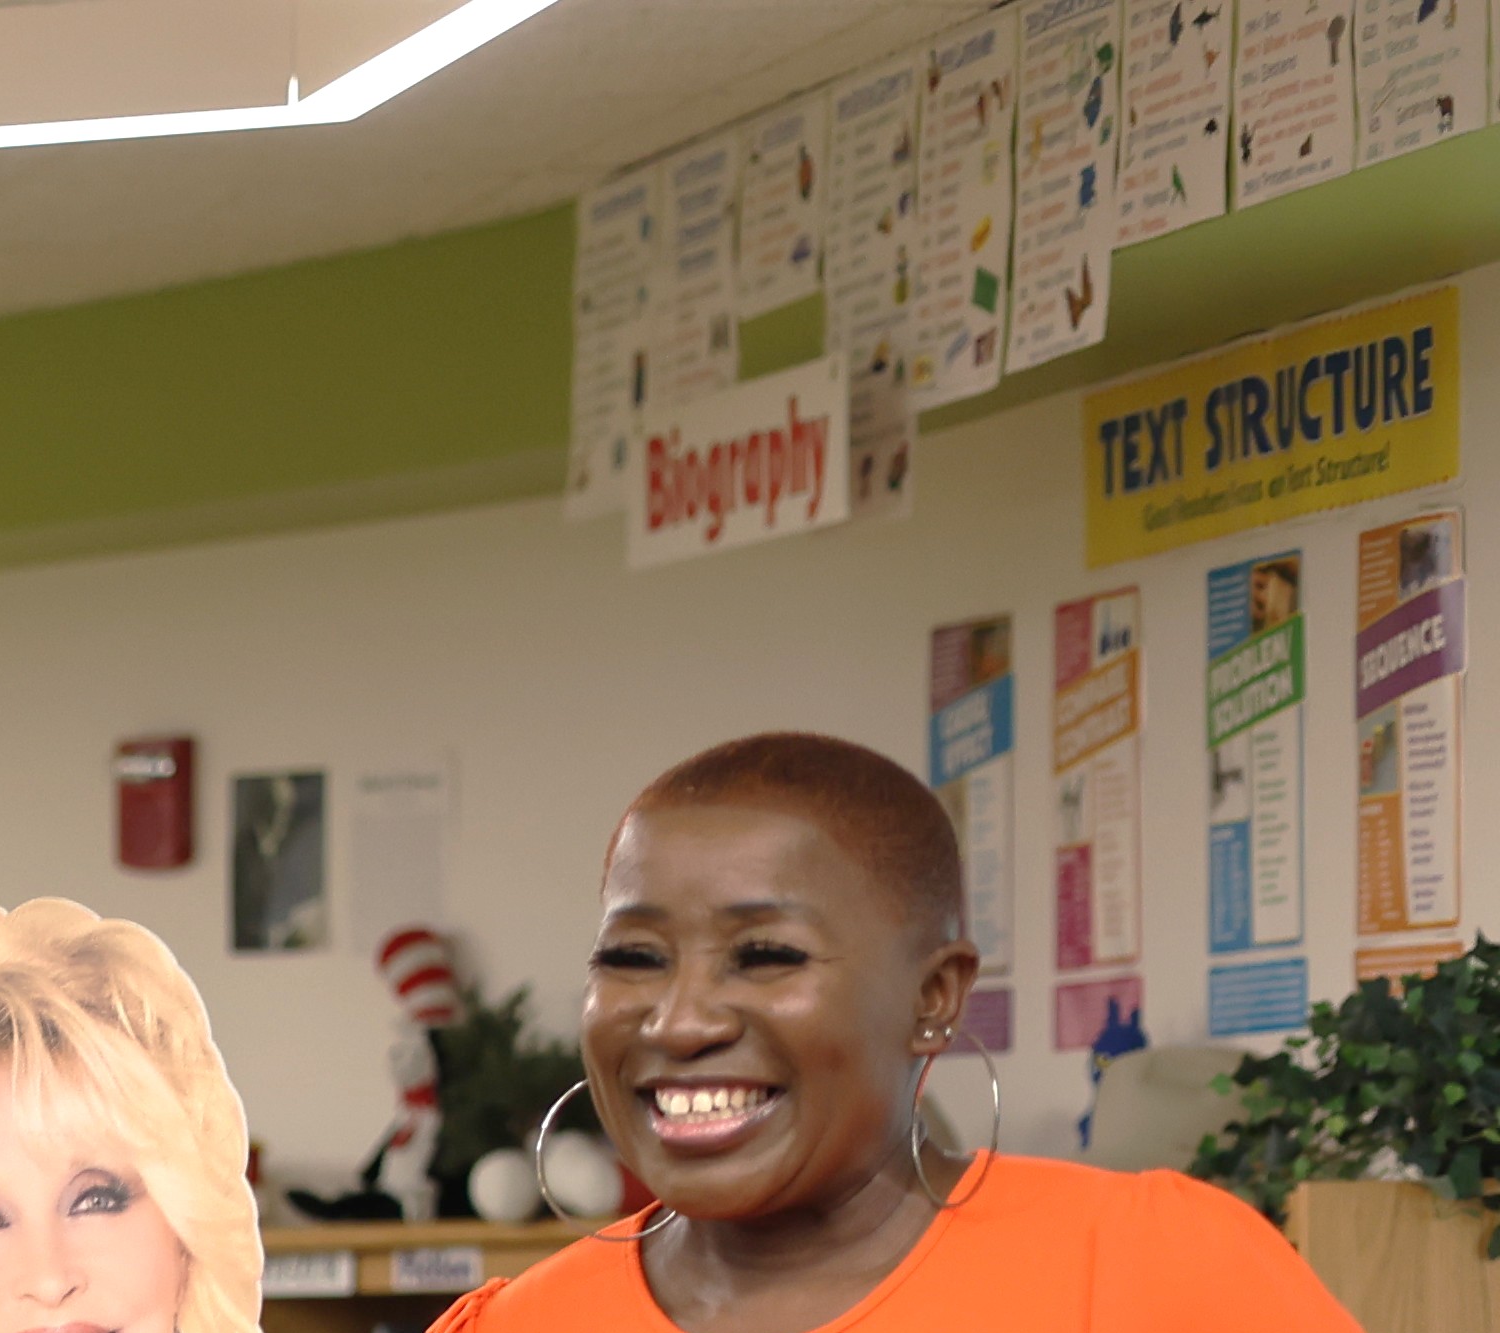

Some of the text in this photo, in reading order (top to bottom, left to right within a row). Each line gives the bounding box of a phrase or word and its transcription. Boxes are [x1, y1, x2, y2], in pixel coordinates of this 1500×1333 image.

[646, 395, 830, 542] Biography
[1098, 326, 1435, 497] TEXT STRUCTURE
[1359, 612, 1447, 690] SEQUENCE
